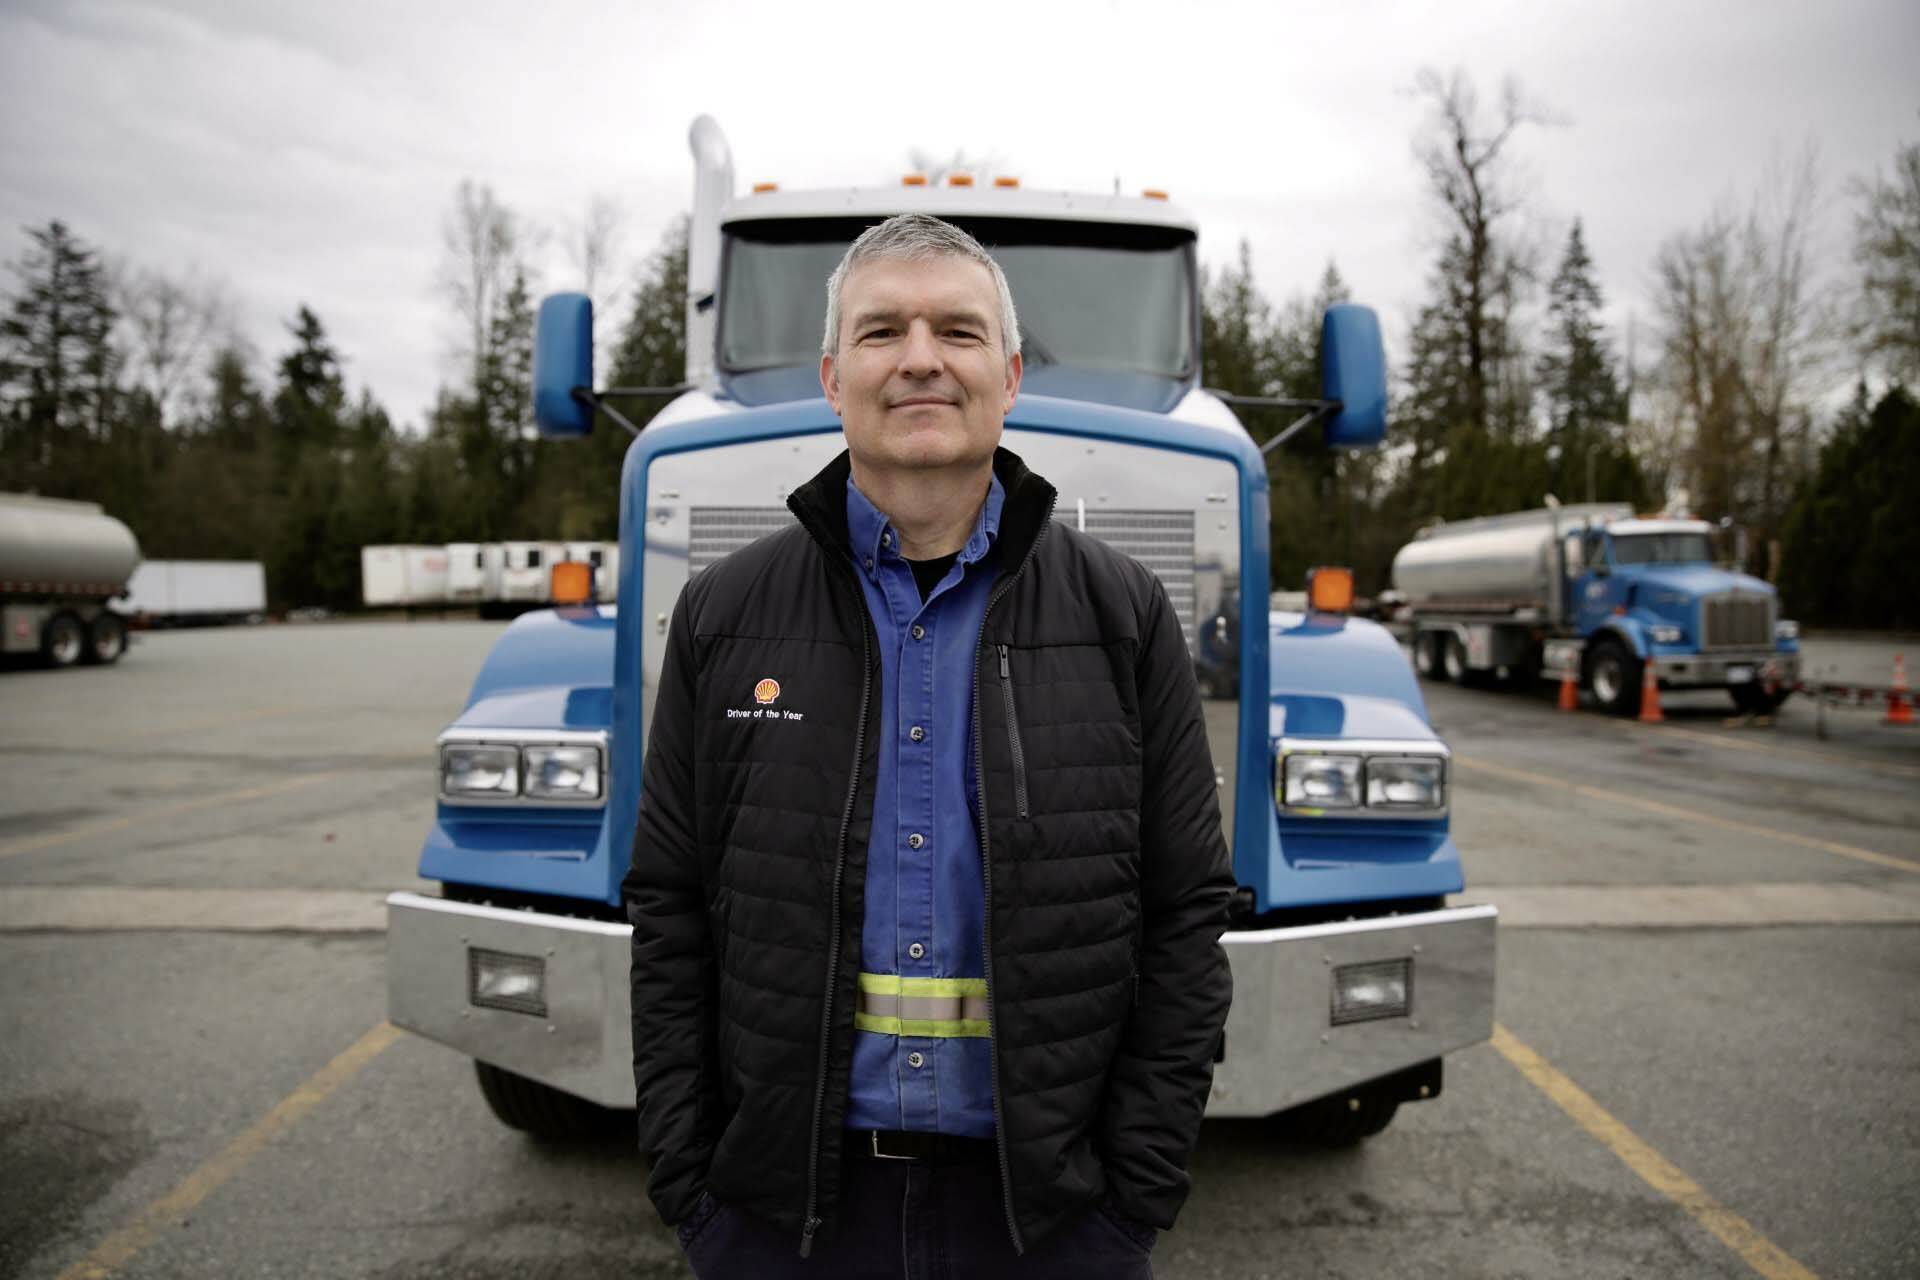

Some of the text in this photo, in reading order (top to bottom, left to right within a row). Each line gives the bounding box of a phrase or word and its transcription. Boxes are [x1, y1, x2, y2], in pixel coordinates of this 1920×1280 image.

[727, 709, 803, 720] Driver of the Year
